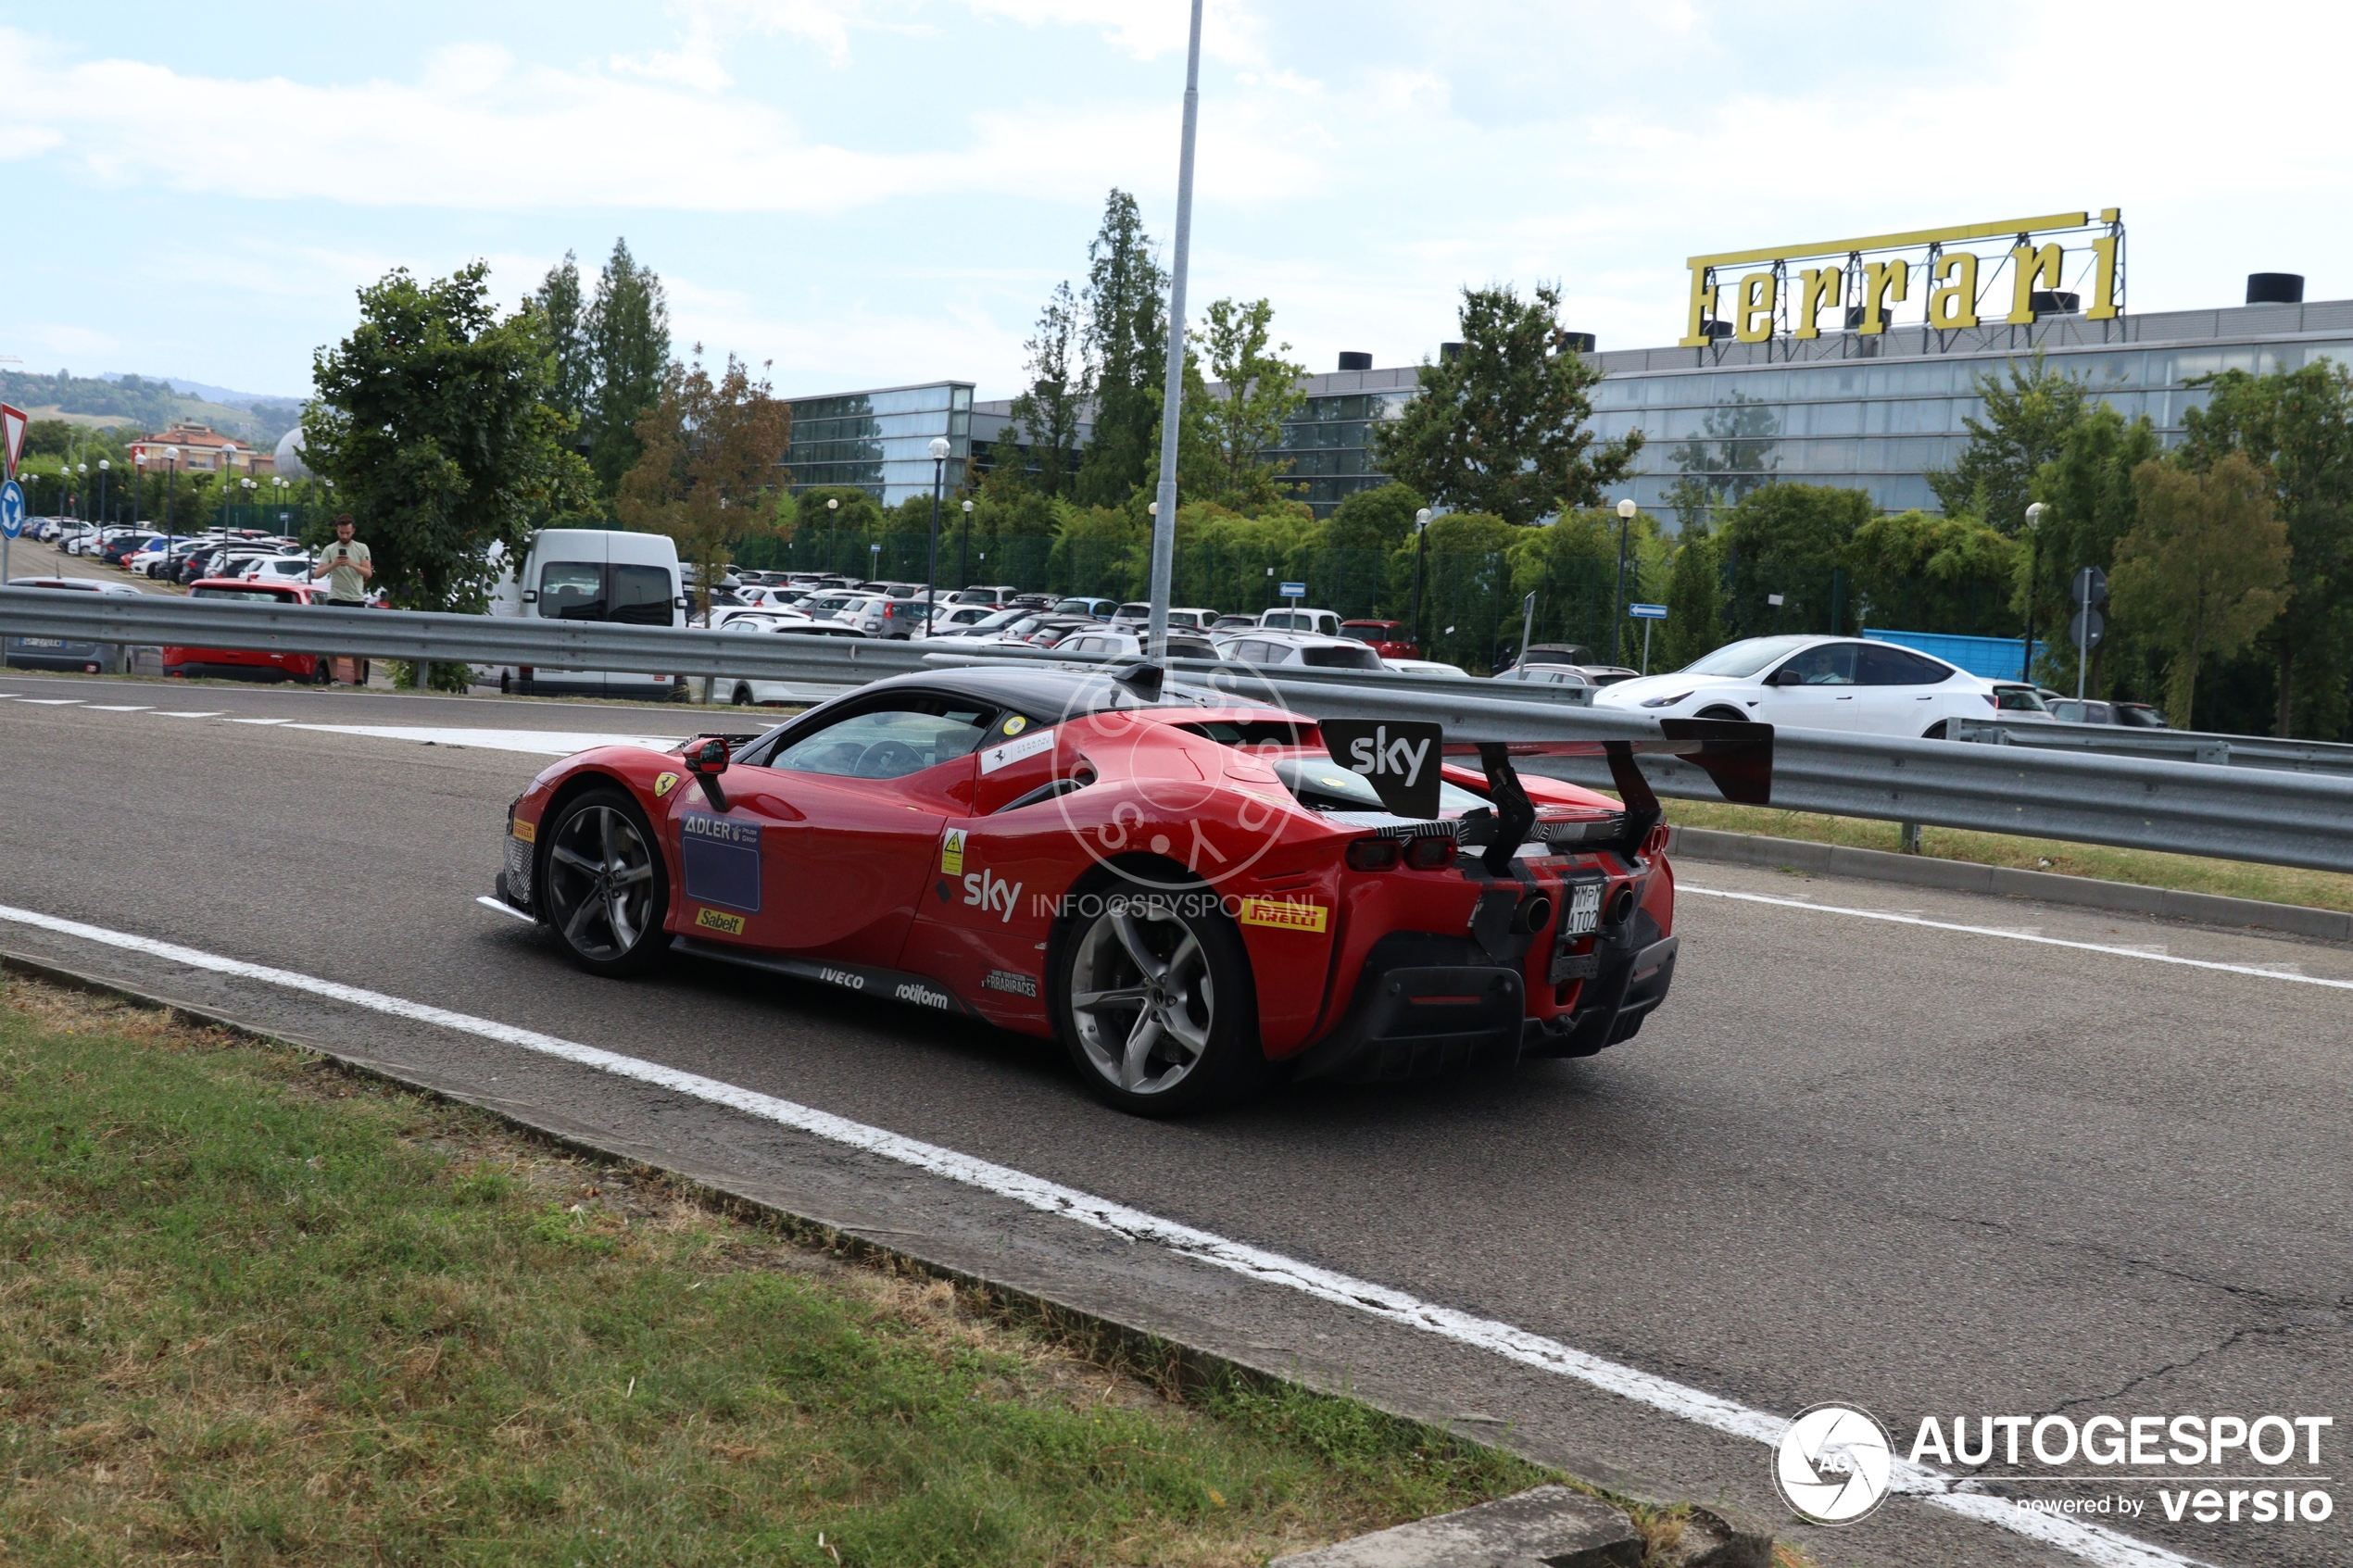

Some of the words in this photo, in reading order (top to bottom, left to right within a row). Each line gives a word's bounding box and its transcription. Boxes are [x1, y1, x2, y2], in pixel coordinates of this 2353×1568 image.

[1679, 207, 2120, 347] Ferrari
[1350, 725, 1430, 787] sky
[684, 815, 731, 840] ADLER
[963, 868, 1023, 923] sky
[700, 909, 740, 933] Sabelt
[1249, 904, 1318, 927] PIRELLI
[819, 967, 864, 990] IVECO
[895, 984, 948, 1010] rotiform
